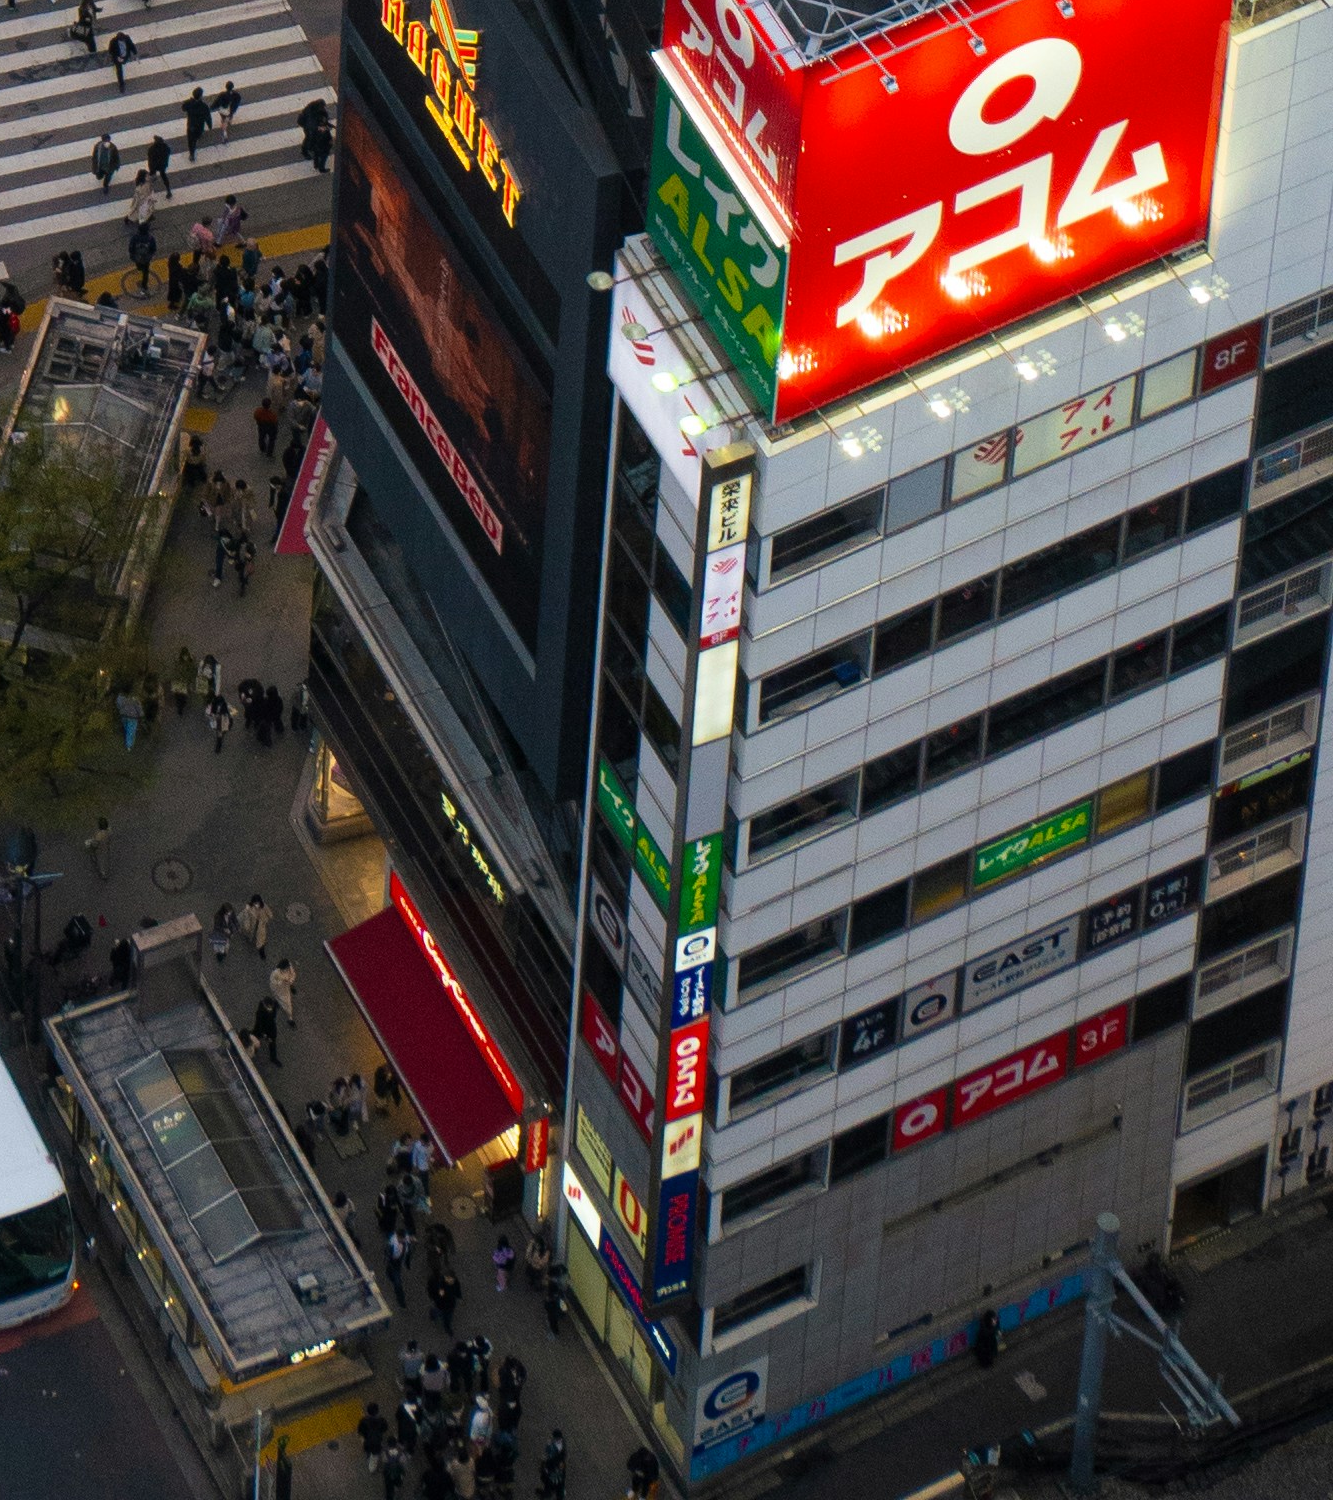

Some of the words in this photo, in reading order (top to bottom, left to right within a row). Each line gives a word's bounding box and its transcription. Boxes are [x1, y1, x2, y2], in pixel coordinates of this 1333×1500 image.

[665, 97, 782, 290] レイク
[833, 117, 1170, 329] アコム
[657, 172, 776, 368] ALSA
[1213, 340, 1246, 370] 8F
[853, 1027, 886, 1053] 4F
[1081, 1018, 1121, 1052] 3F
[960, 1048, 1060, 1112] アコム
[665, 1194, 690, 1267] PROMISE
